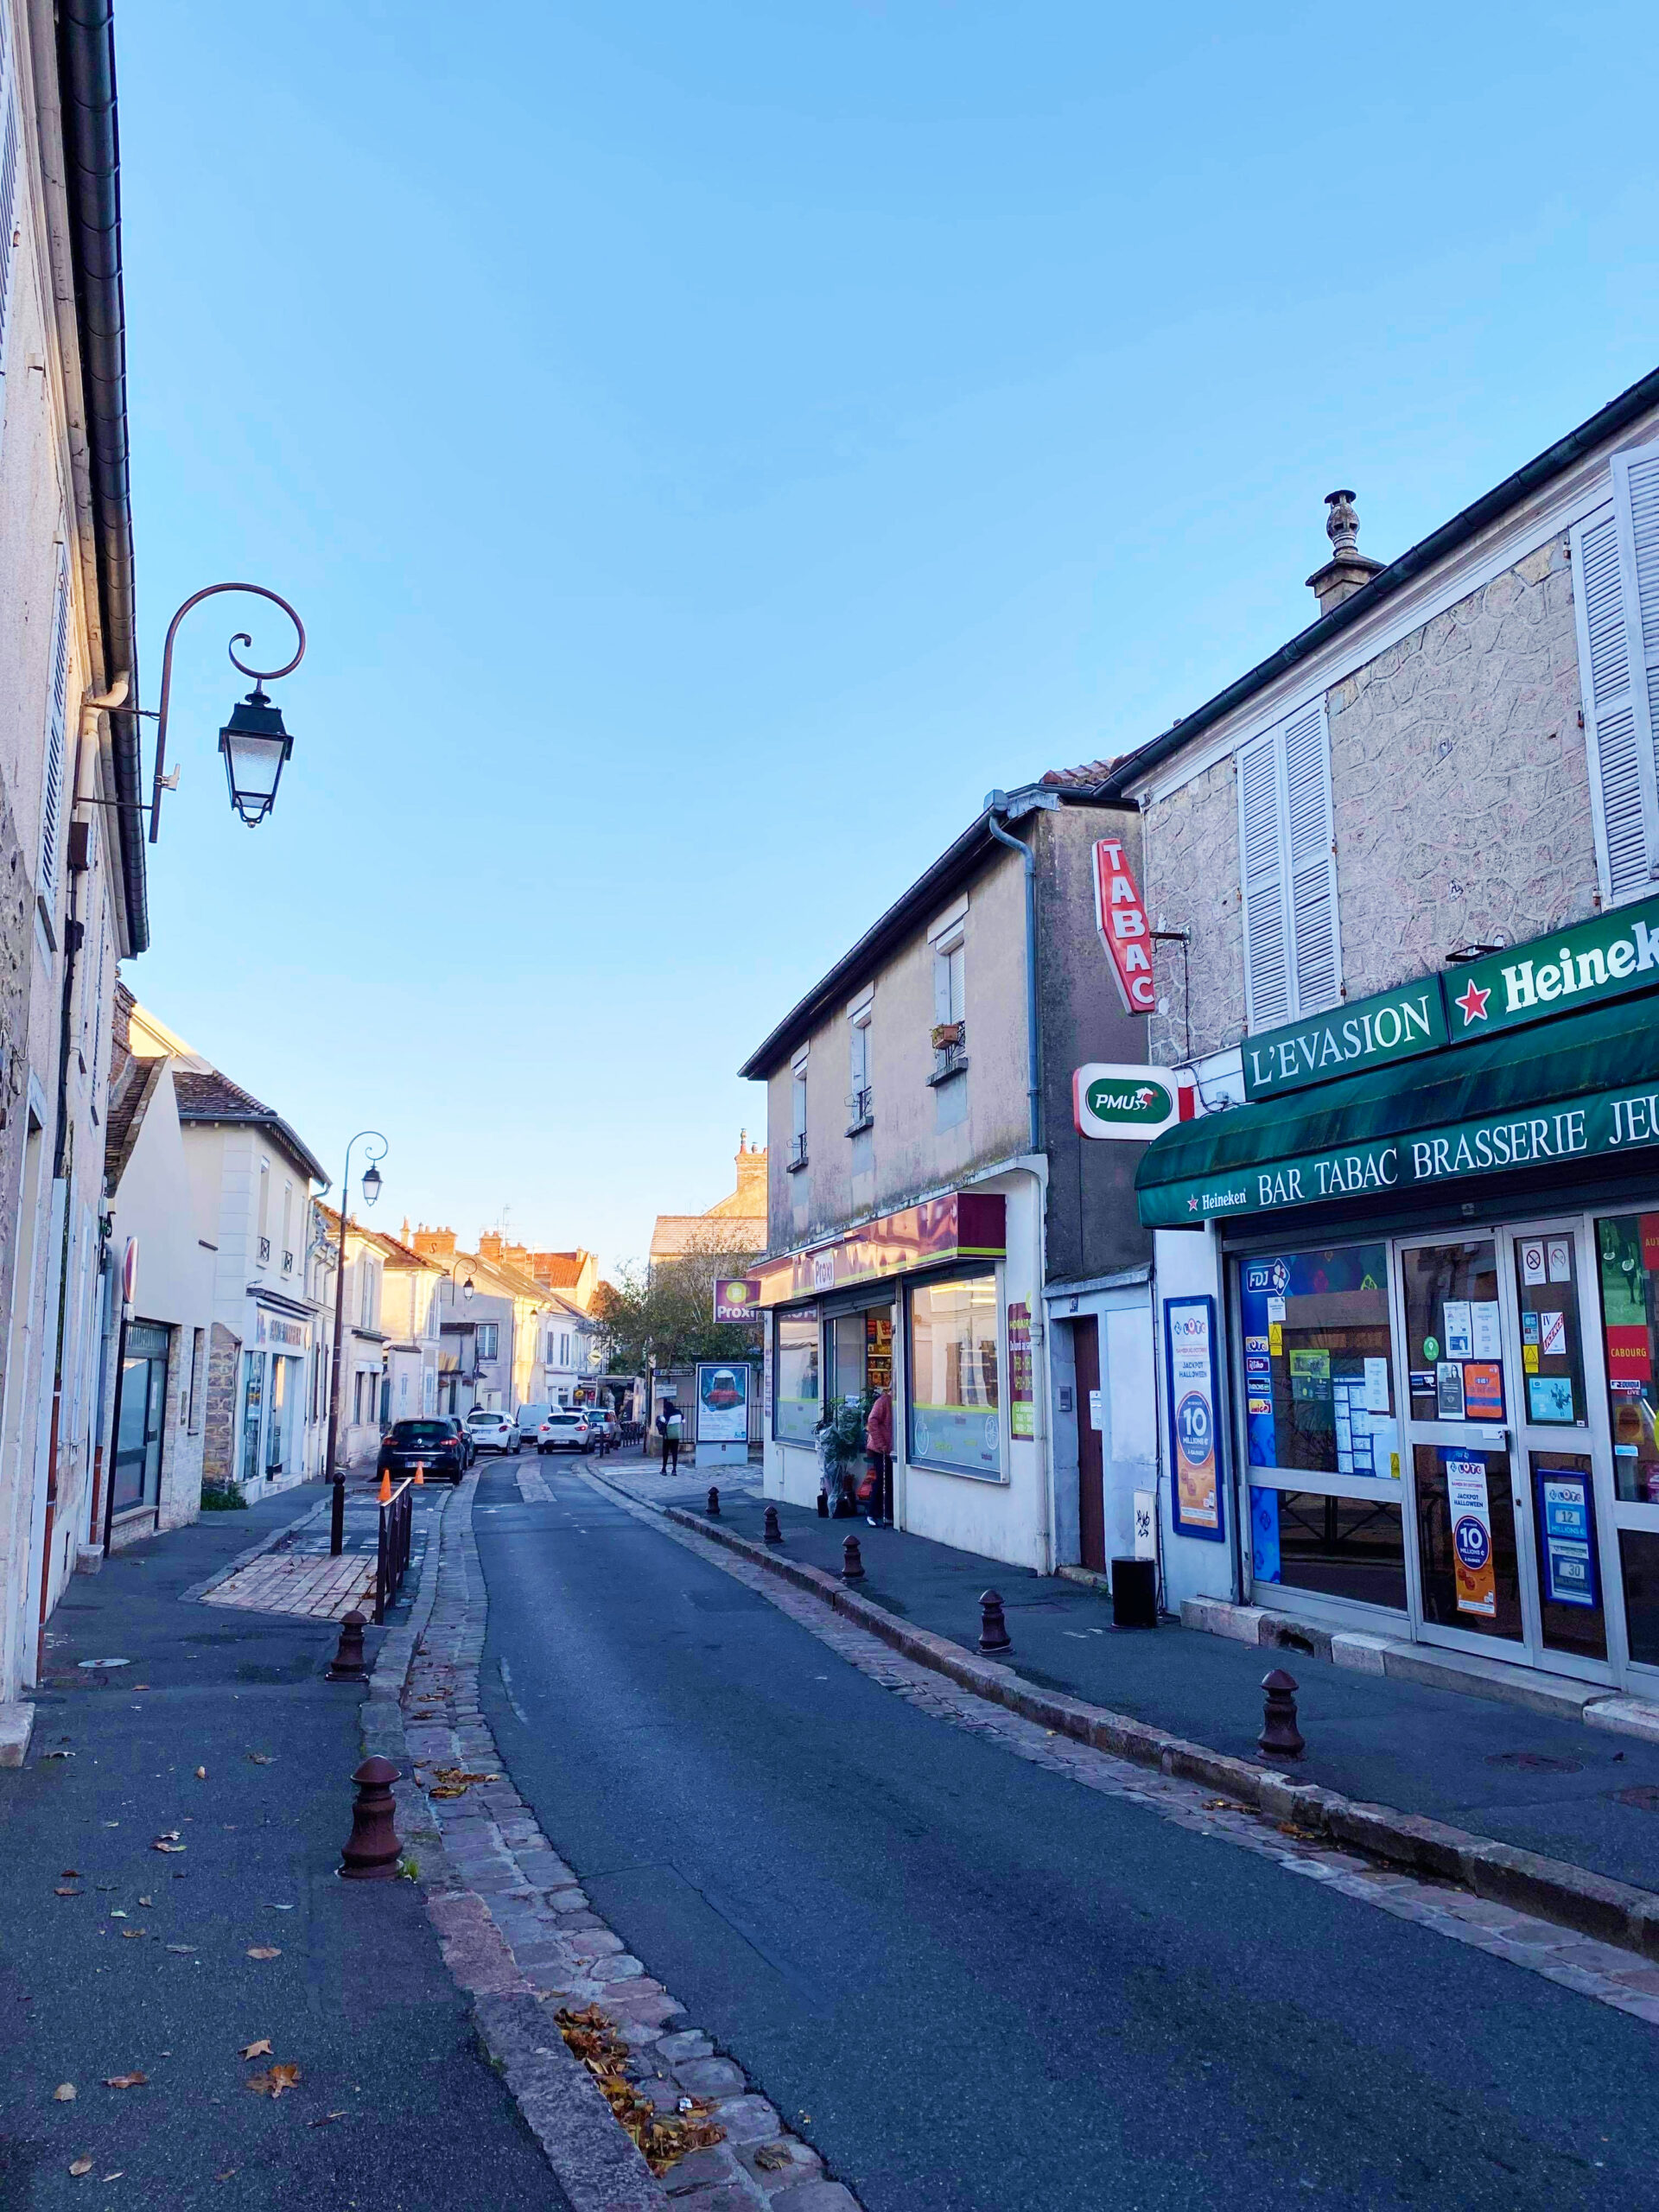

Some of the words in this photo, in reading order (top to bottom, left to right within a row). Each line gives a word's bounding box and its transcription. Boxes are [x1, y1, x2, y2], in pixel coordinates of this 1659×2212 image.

[1103, 844, 1154, 1004] TABAC
[1250, 995, 1431, 1086] L'EVASION
[1096, 1094, 1135, 1109] PMU
[1202, 1190, 1247, 1210] Heineken
[1258, 1169, 1305, 1206] BAR
[1314, 1148, 1398, 1194] TABAC
[1411, 1110, 1587, 1179] BRASSERIE
[1249, 1271, 1268, 1287] FDJ
[717, 1306, 754, 1318] Proxi
[1543, 1315, 1564, 1351] LICENCE
[1611, 1348, 1647, 1357] CABOURG
[1184, 1408, 1207, 1436] 10
[1459, 1462, 1482, 1474] LOTO
[1558, 1489, 1581, 1502] LOTO
[1561, 1510, 1573, 1522] 12
[1459, 1527, 1483, 1549] 10
[1568, 1566, 1580, 1576] 30
